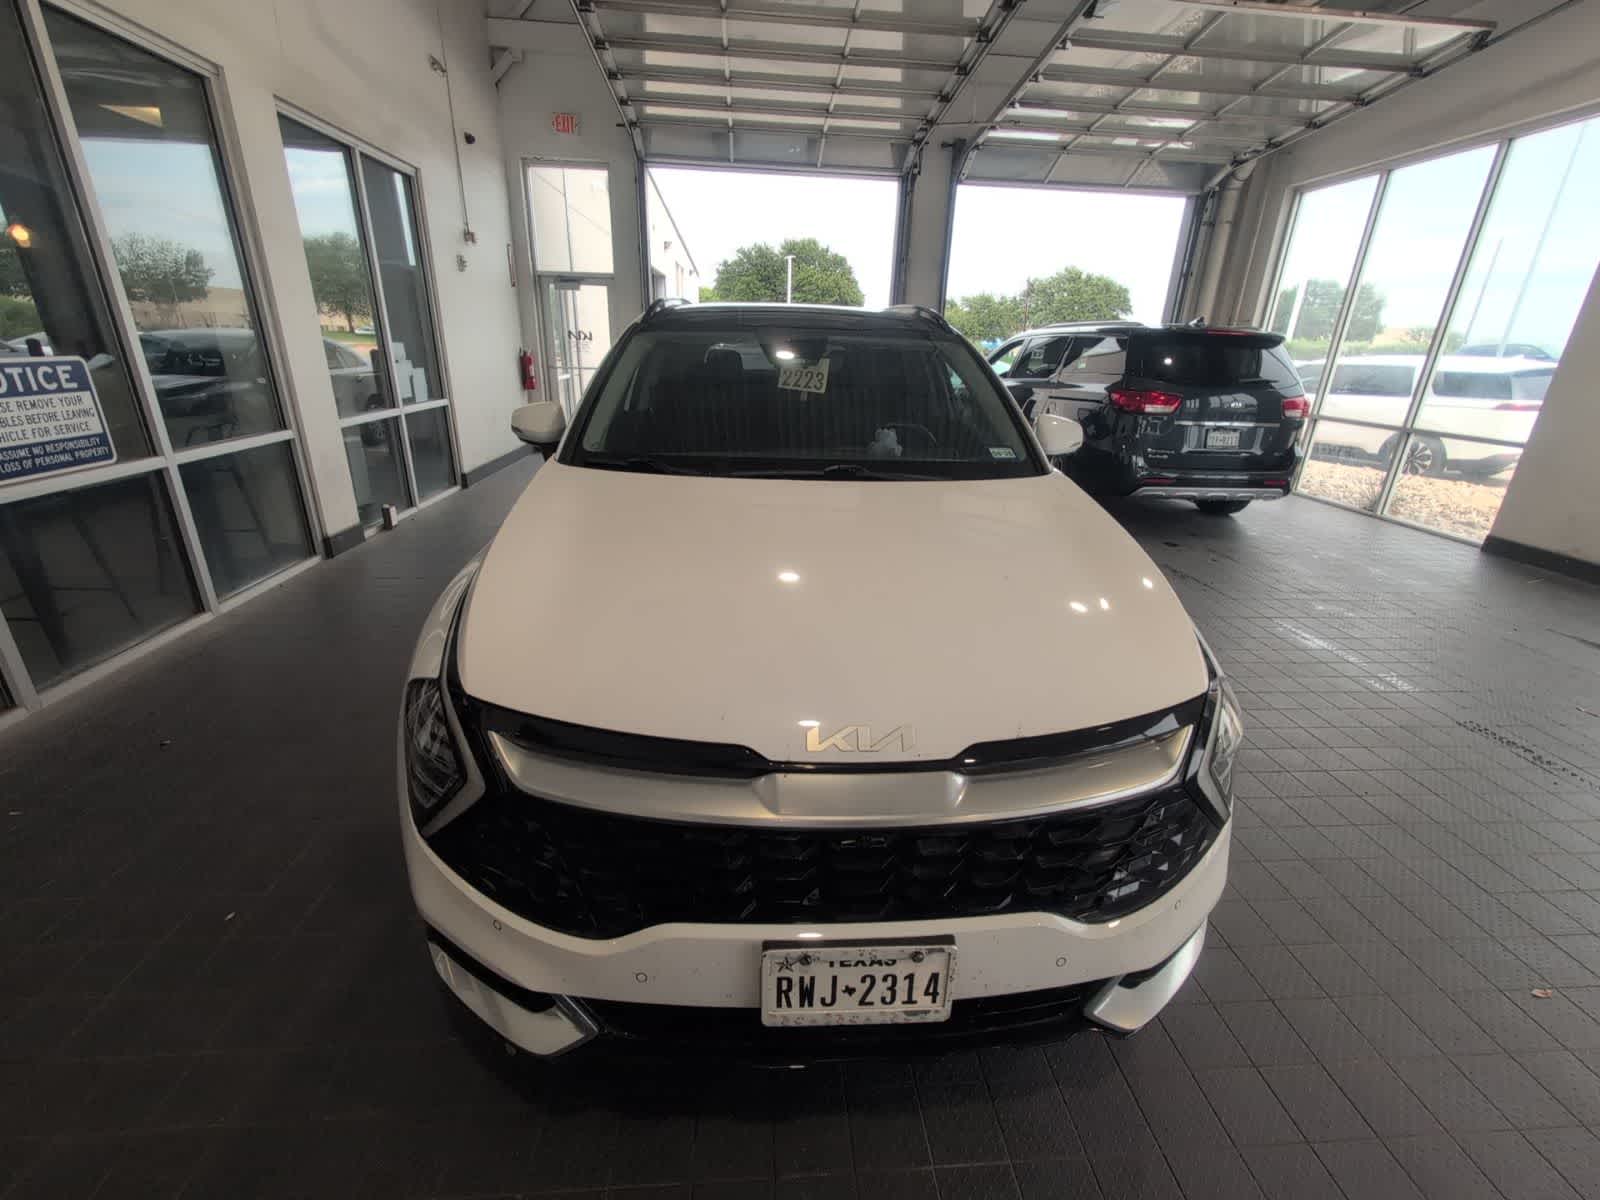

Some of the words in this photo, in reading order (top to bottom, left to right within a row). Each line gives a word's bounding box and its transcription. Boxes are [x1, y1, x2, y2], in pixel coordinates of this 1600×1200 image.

[554, 115, 577, 133] EXIT
[783, 370, 825, 391] 2223
[0, 401, 14, 414] SE
[15, 398, 57, 413] REMOVE
[59, 394, 84, 408] YOUR
[25, 411, 61, 425] BEFORE
[61, 407, 95, 421] LEAVING
[31, 426, 52, 440] FOR
[54, 420, 92, 436] SERVICE
[32, 445, 45, 457] NO
[46, 437, 100, 454] RESPONSIBILITY
[0, 460, 22, 474] LOSS
[22, 458, 33, 470] OF
[35, 453, 73, 467] PERSONAL
[74, 446, 109, 459] PROPERTY
[857, 971, 941, 1007] 2314
